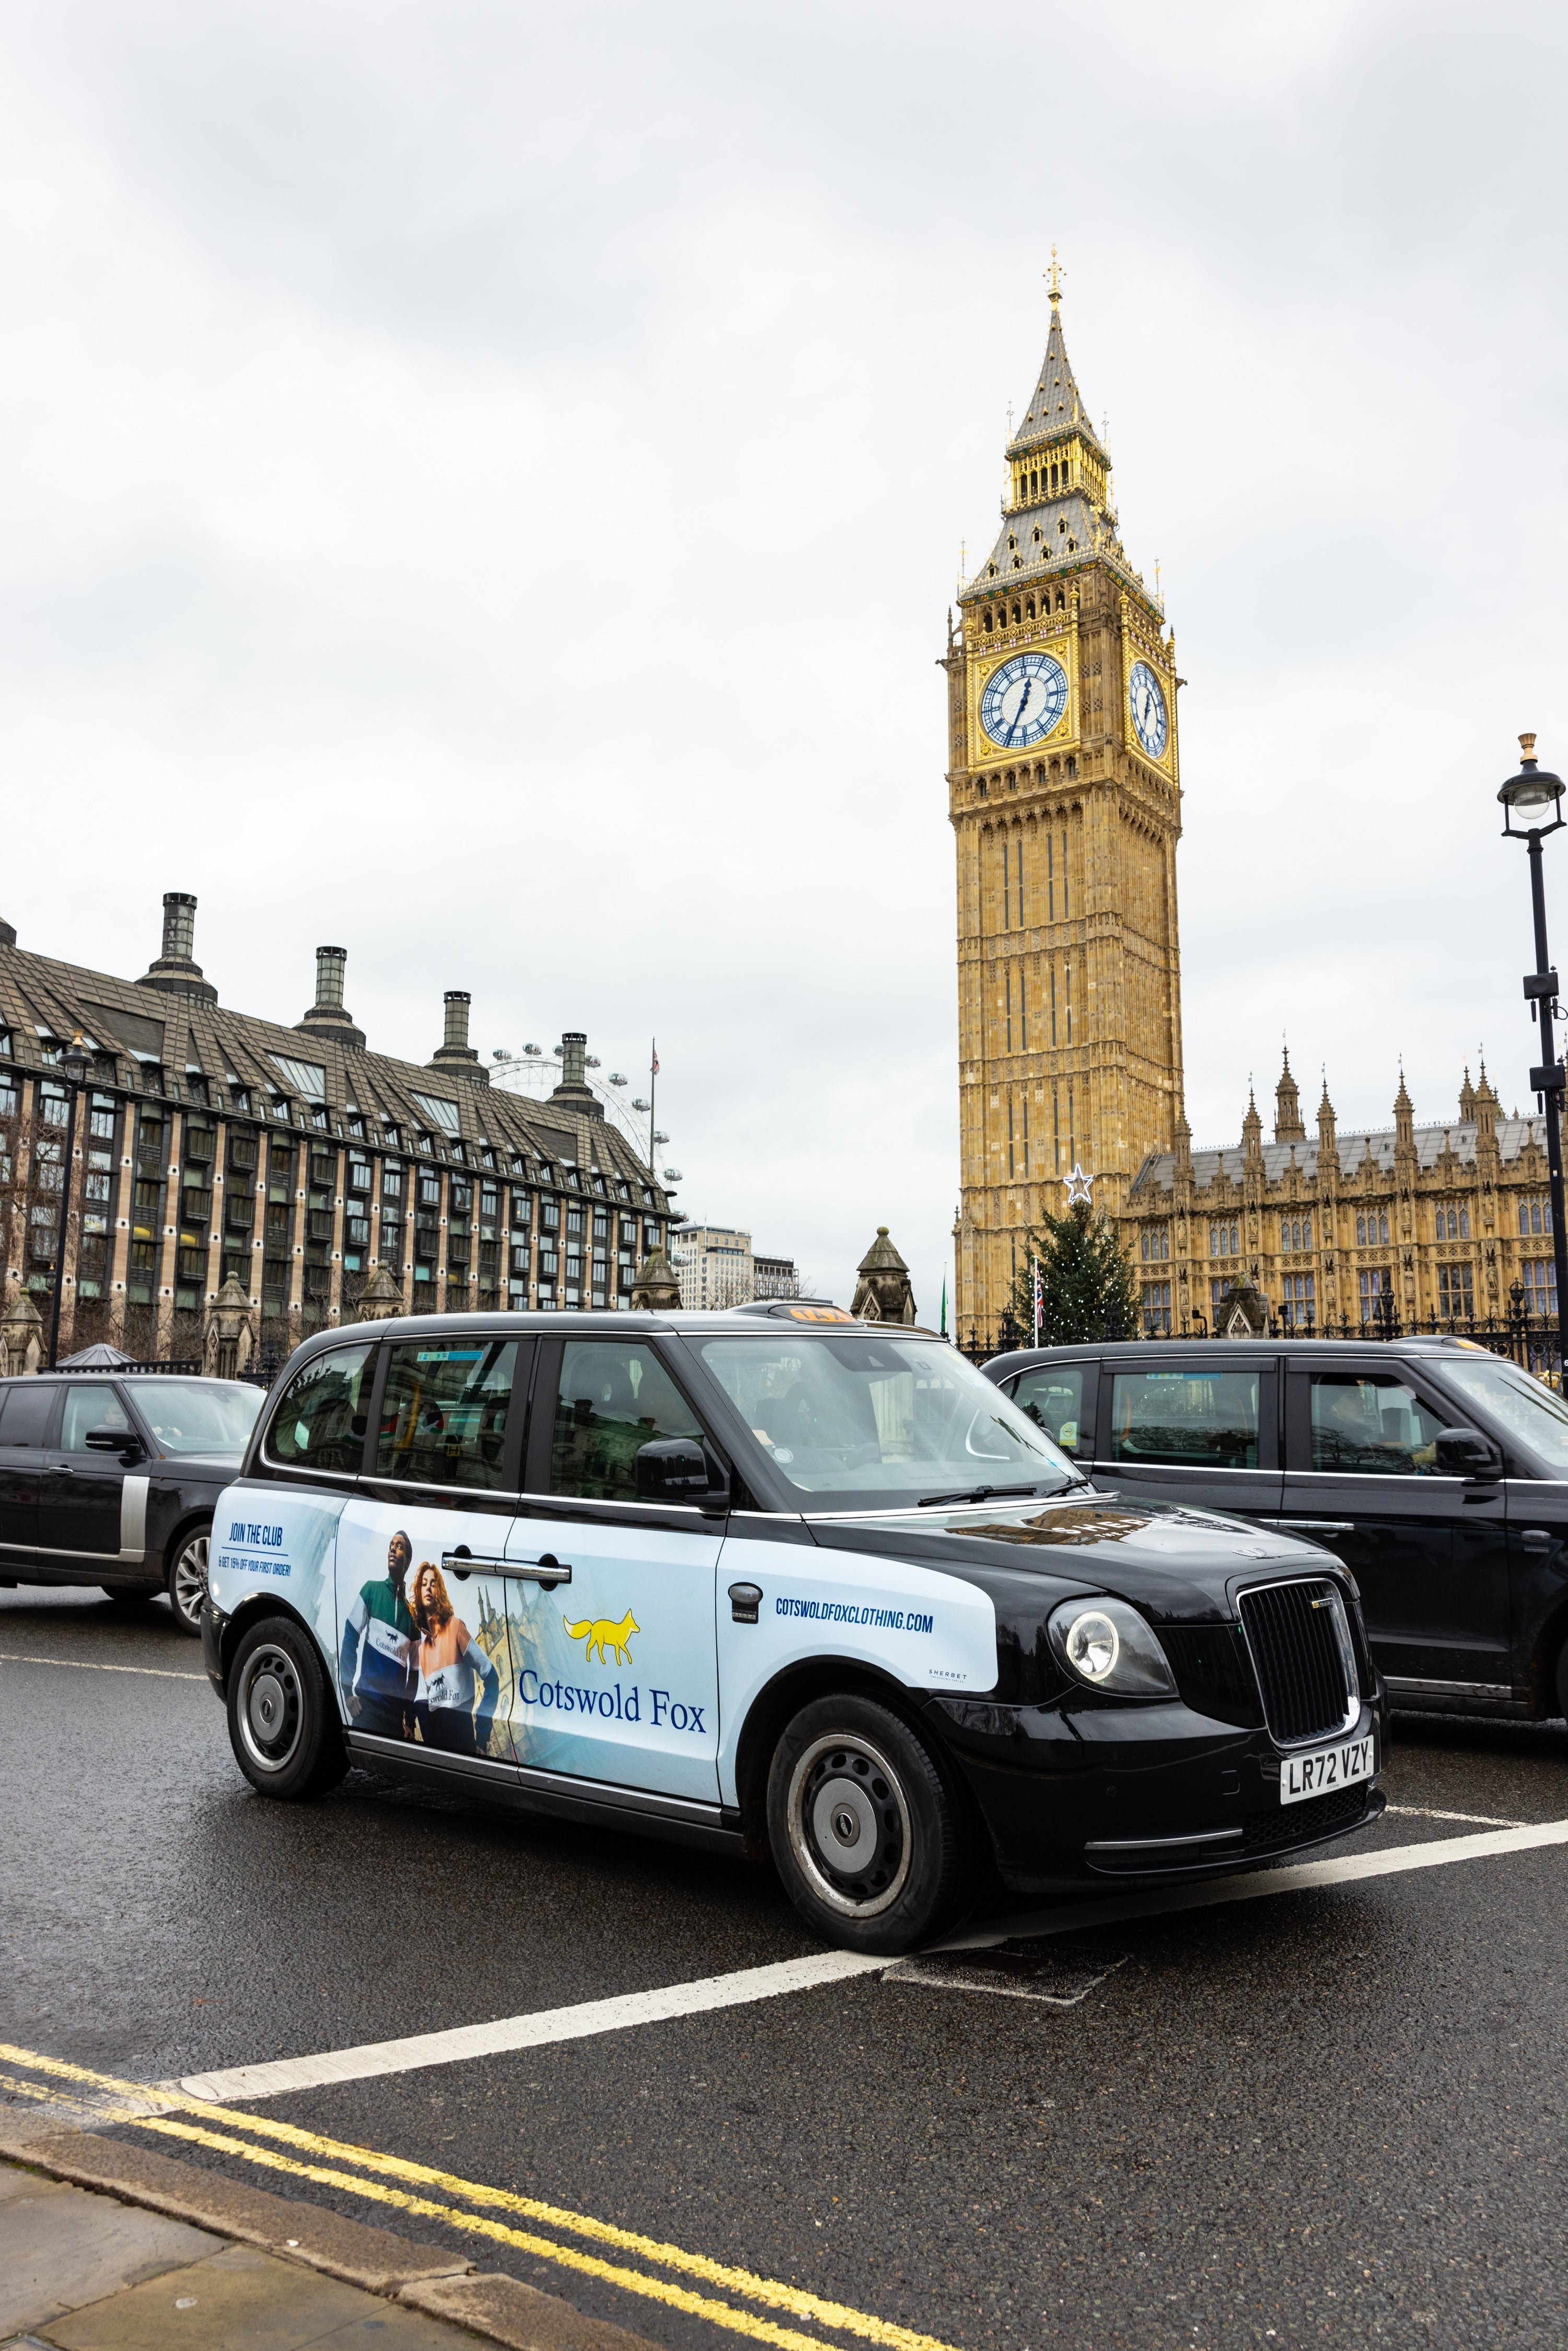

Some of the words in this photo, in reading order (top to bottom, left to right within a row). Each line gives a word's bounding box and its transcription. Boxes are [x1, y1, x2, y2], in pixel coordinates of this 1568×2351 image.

[795, 1309, 853, 1321] TAXI
[229, 1522, 246, 1542] JOIN
[247, 1524, 261, 1544] THE
[262, 1526, 283, 1546] CLUB
[218, 1556, 222, 1567] &
[230, 1557, 239, 1569] 15%
[248, 1559, 259, 1572] YOUR
[259, 1561, 273, 1574] FIRST
[273, 1563, 291, 1576] ORDER!
[775, 1597, 934, 1634] COTSWOLDFOXCLOTHING.COM
[376, 1637, 398, 1656] Cotswold
[928, 1669, 967, 1680] SHERBET
[448, 1690, 460, 1701] Fox
[519, 1669, 642, 1722] Cotswold
[648, 1689, 706, 1733] Fox
[1289, 1752, 1337, 1795] LR72
[1342, 1740, 1368, 1778] VZY
